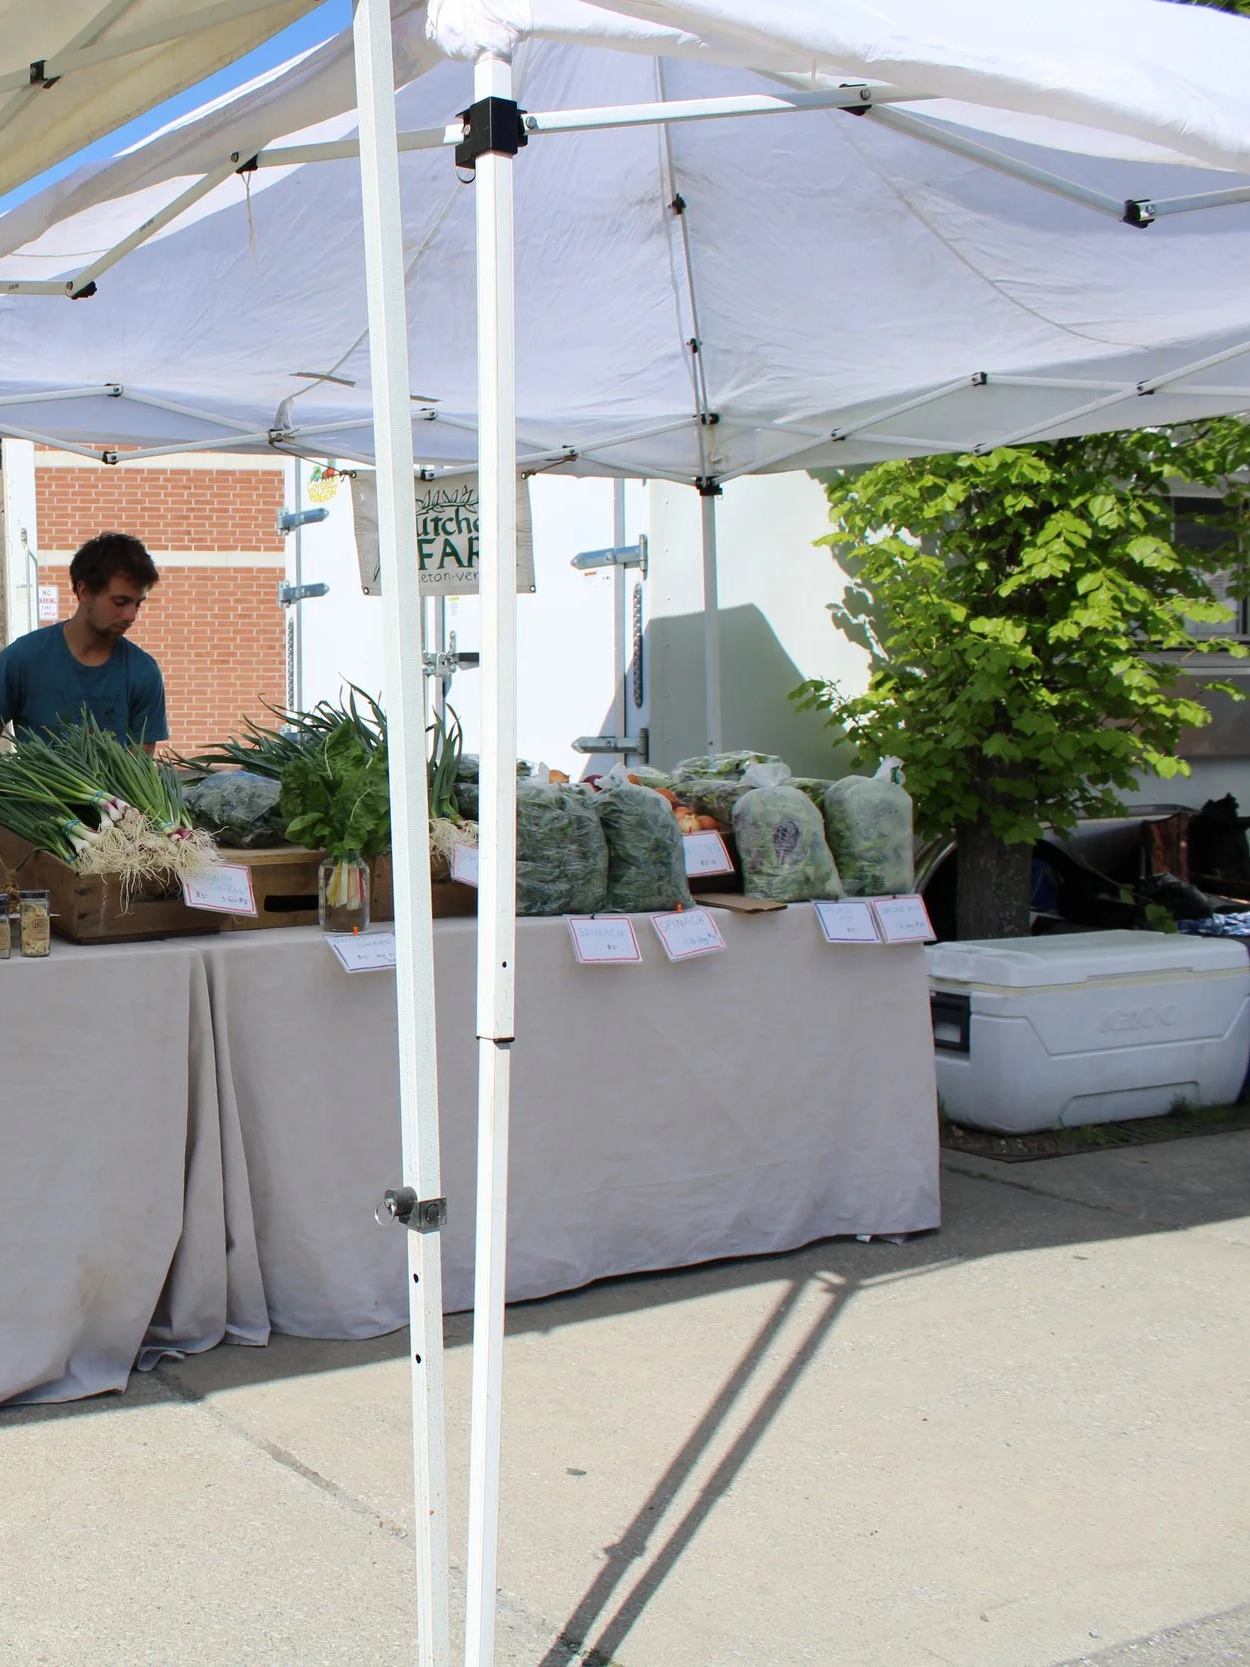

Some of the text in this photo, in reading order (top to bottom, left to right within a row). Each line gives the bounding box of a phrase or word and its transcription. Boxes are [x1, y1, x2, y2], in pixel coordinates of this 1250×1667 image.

[415, 506, 479, 538] utche
[416, 536, 479, 571] FAR
[578, 927, 625, 938] SPINACH
[659, 915, 705, 932] SPINACH
[1098, 1003, 1179, 1034] IGLOO
